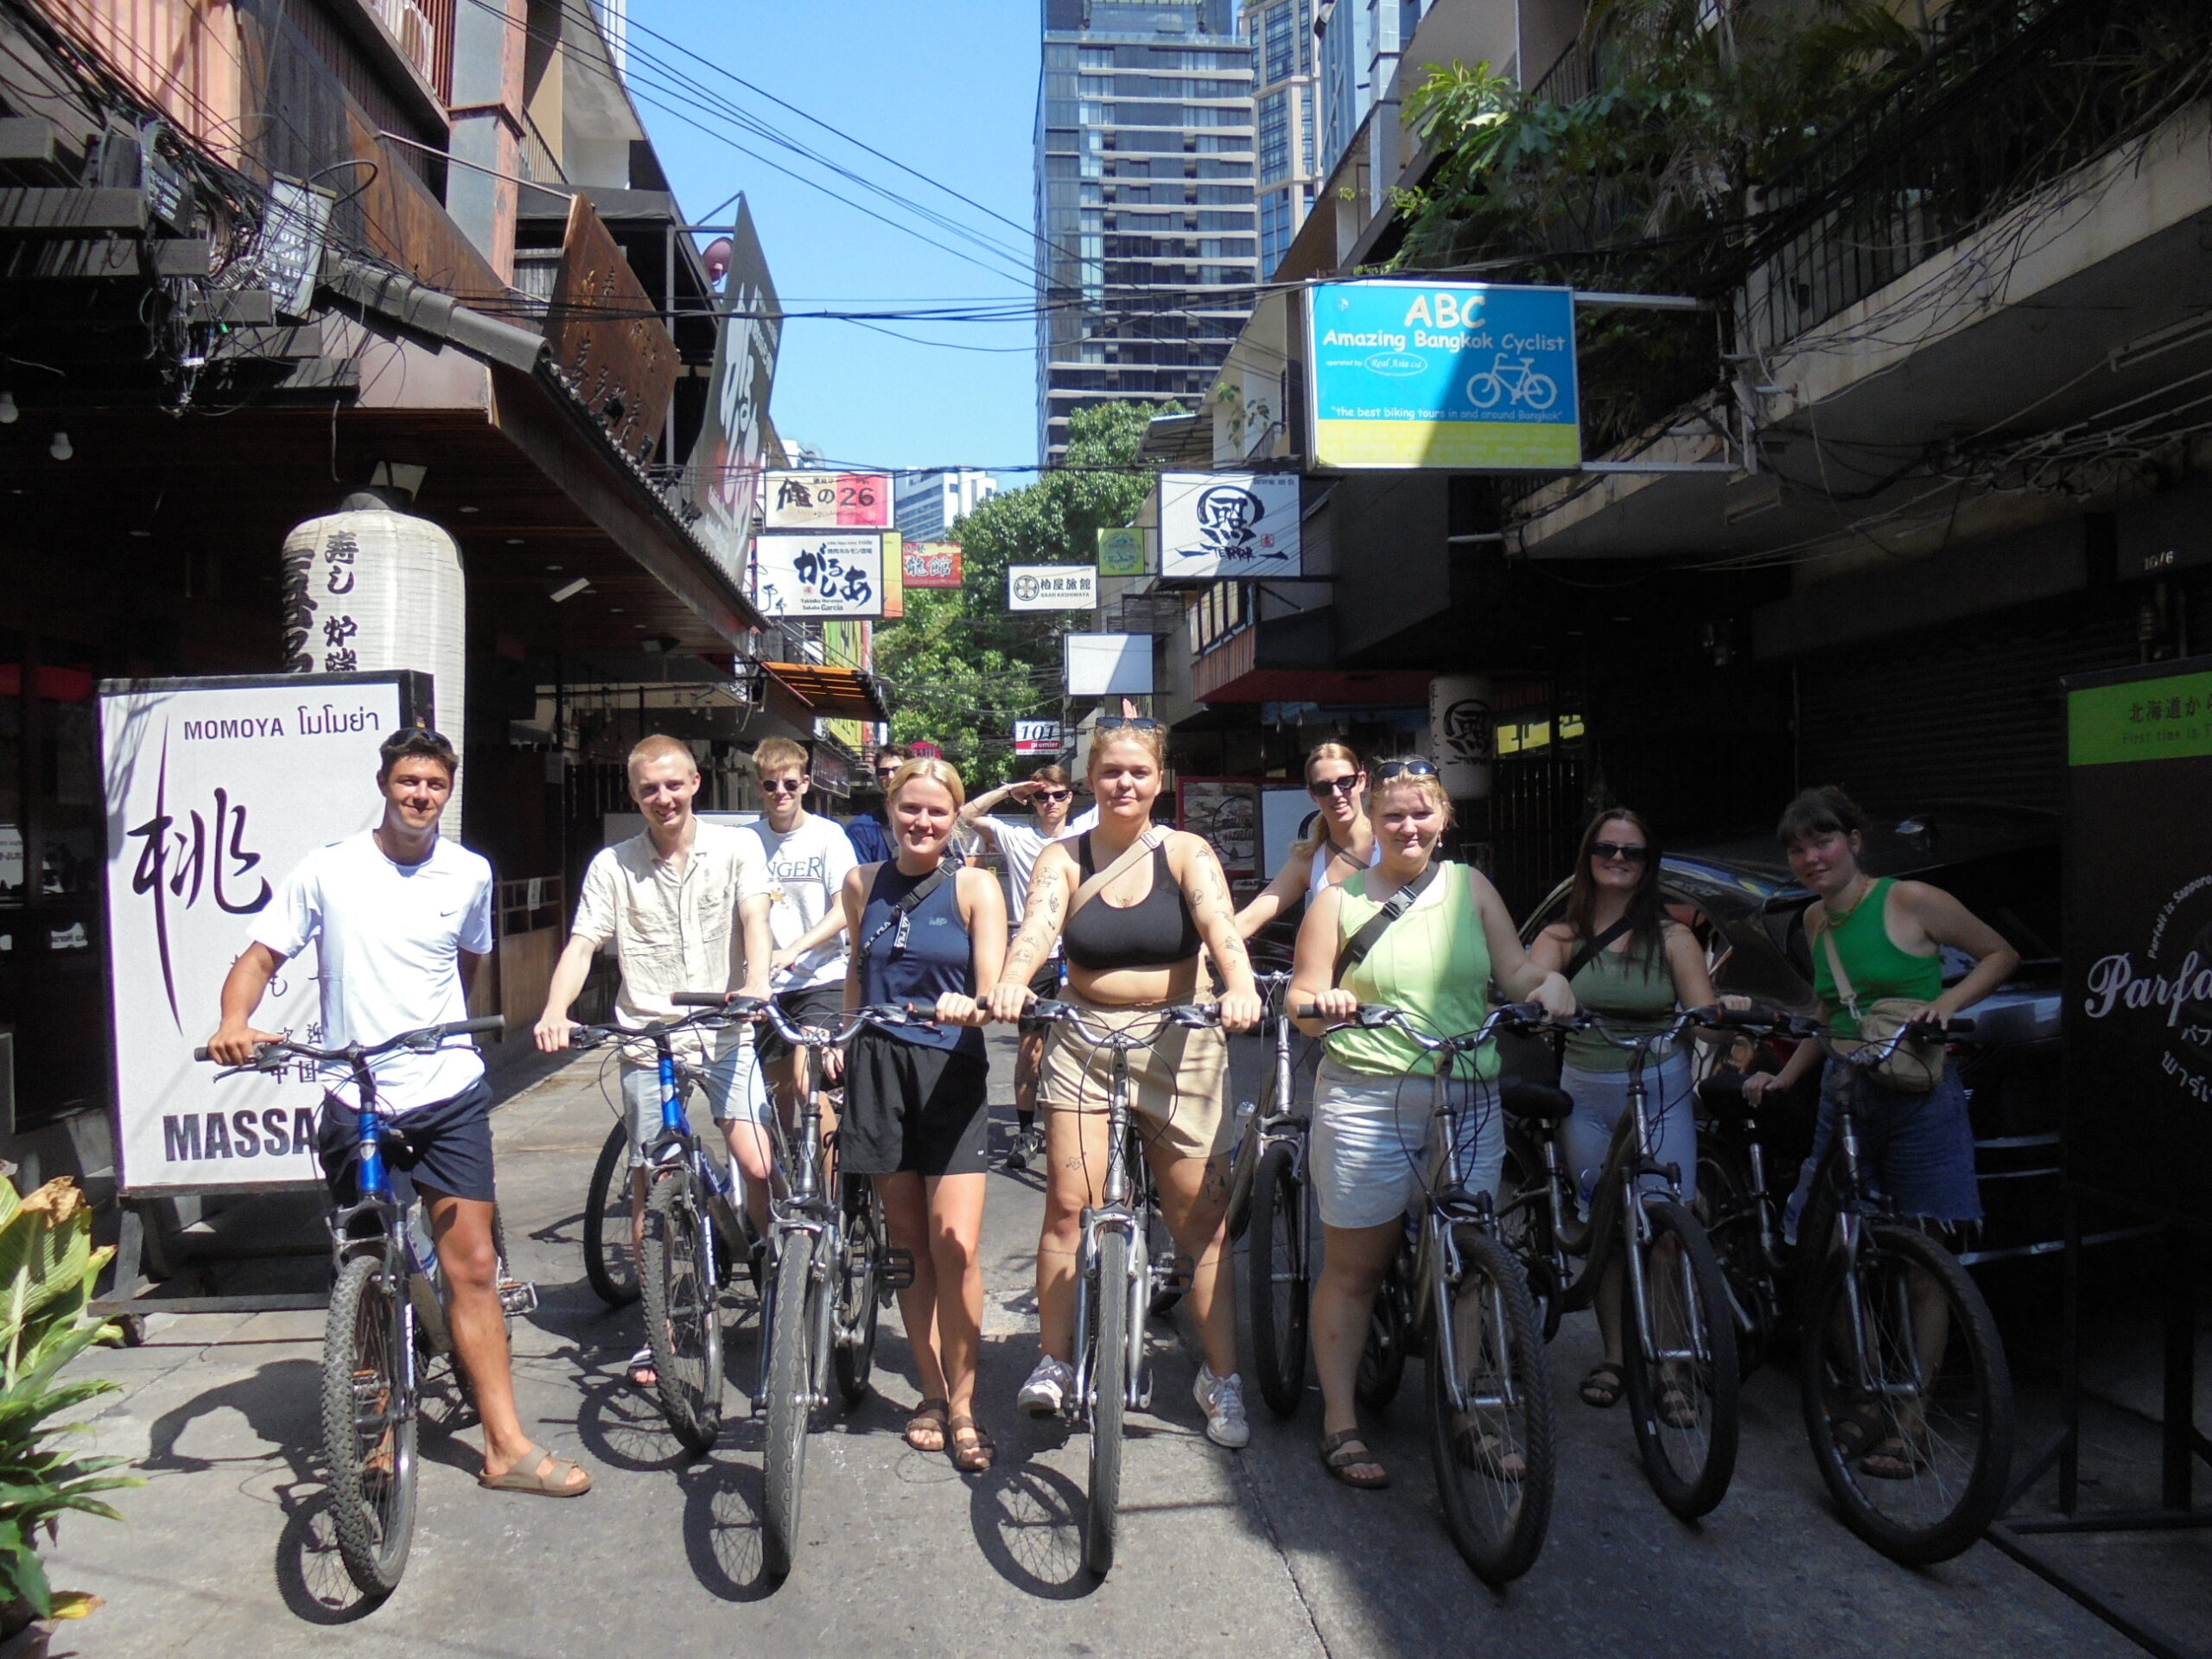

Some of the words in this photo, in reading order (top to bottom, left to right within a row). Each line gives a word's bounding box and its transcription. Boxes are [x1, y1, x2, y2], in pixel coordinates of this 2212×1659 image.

[1403, 293, 1487, 329] ABC
[1322, 328, 1407, 353] Amazing
[1414, 329, 1494, 353] Bangkok
[1501, 334, 1566, 355] Cyclist
[1370, 358, 1390, 369] Real
[1390, 358, 1409, 369] Asia
[1357, 407, 1382, 417] best
[1384, 407, 1415, 421] biking
[1417, 408, 1445, 419] tours
[1448, 408, 1458, 418] in
[1459, 409, 1478, 419] and
[1481, 410, 1516, 420] around
[1040, 577, 1091, 591] 柏屋旅館
[183, 717, 284, 741] MOMOYA
[297, 704, 380, 736] โมโมย่า
[1021, 725, 1054, 740] 101
